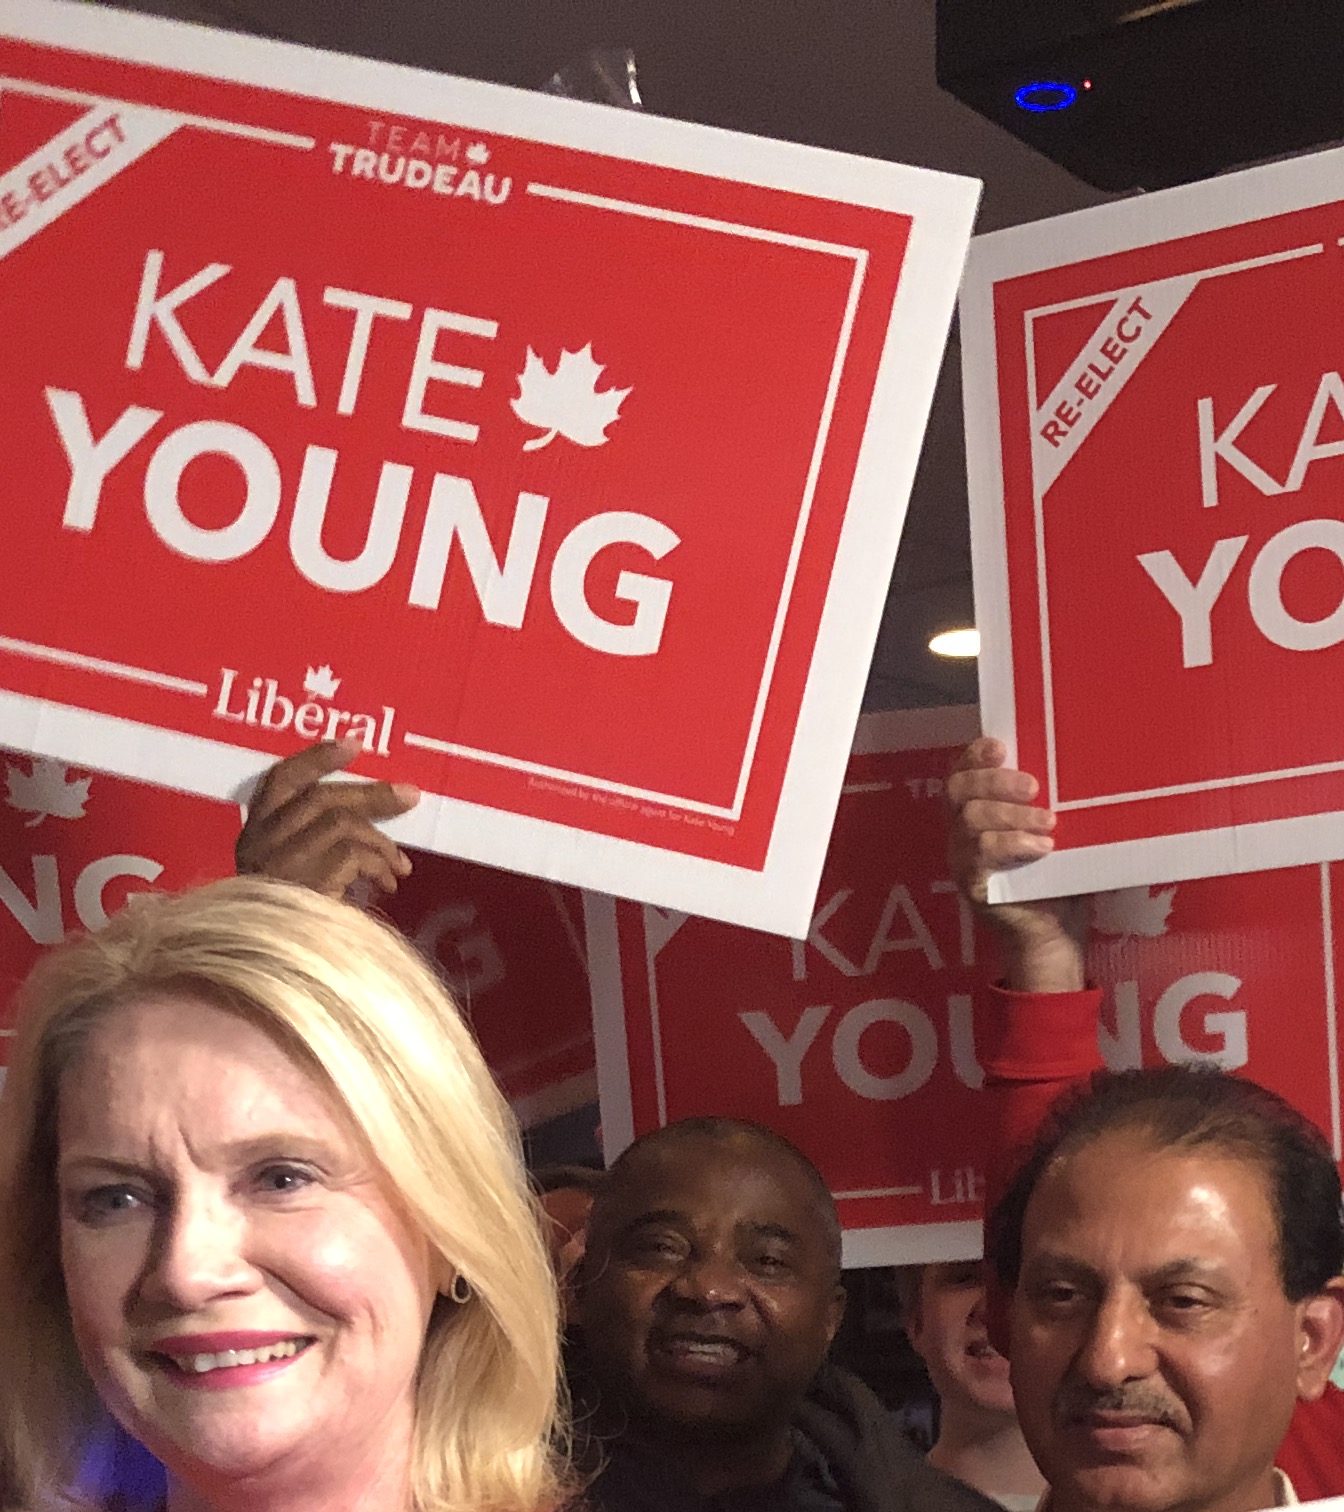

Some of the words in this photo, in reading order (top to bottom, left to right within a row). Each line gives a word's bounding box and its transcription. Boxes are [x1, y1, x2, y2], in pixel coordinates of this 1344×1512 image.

[327, 141, 513, 205] TRUDEAU
[367, 119, 464, 158] TEAM
[125, 248, 500, 443] KATE
[1039, 296, 1158, 449] RE-ELECT
[44, 385, 682, 657] YOUNG
[210, 667, 396, 756] Liberal
[790, 881, 976, 982] KAT
